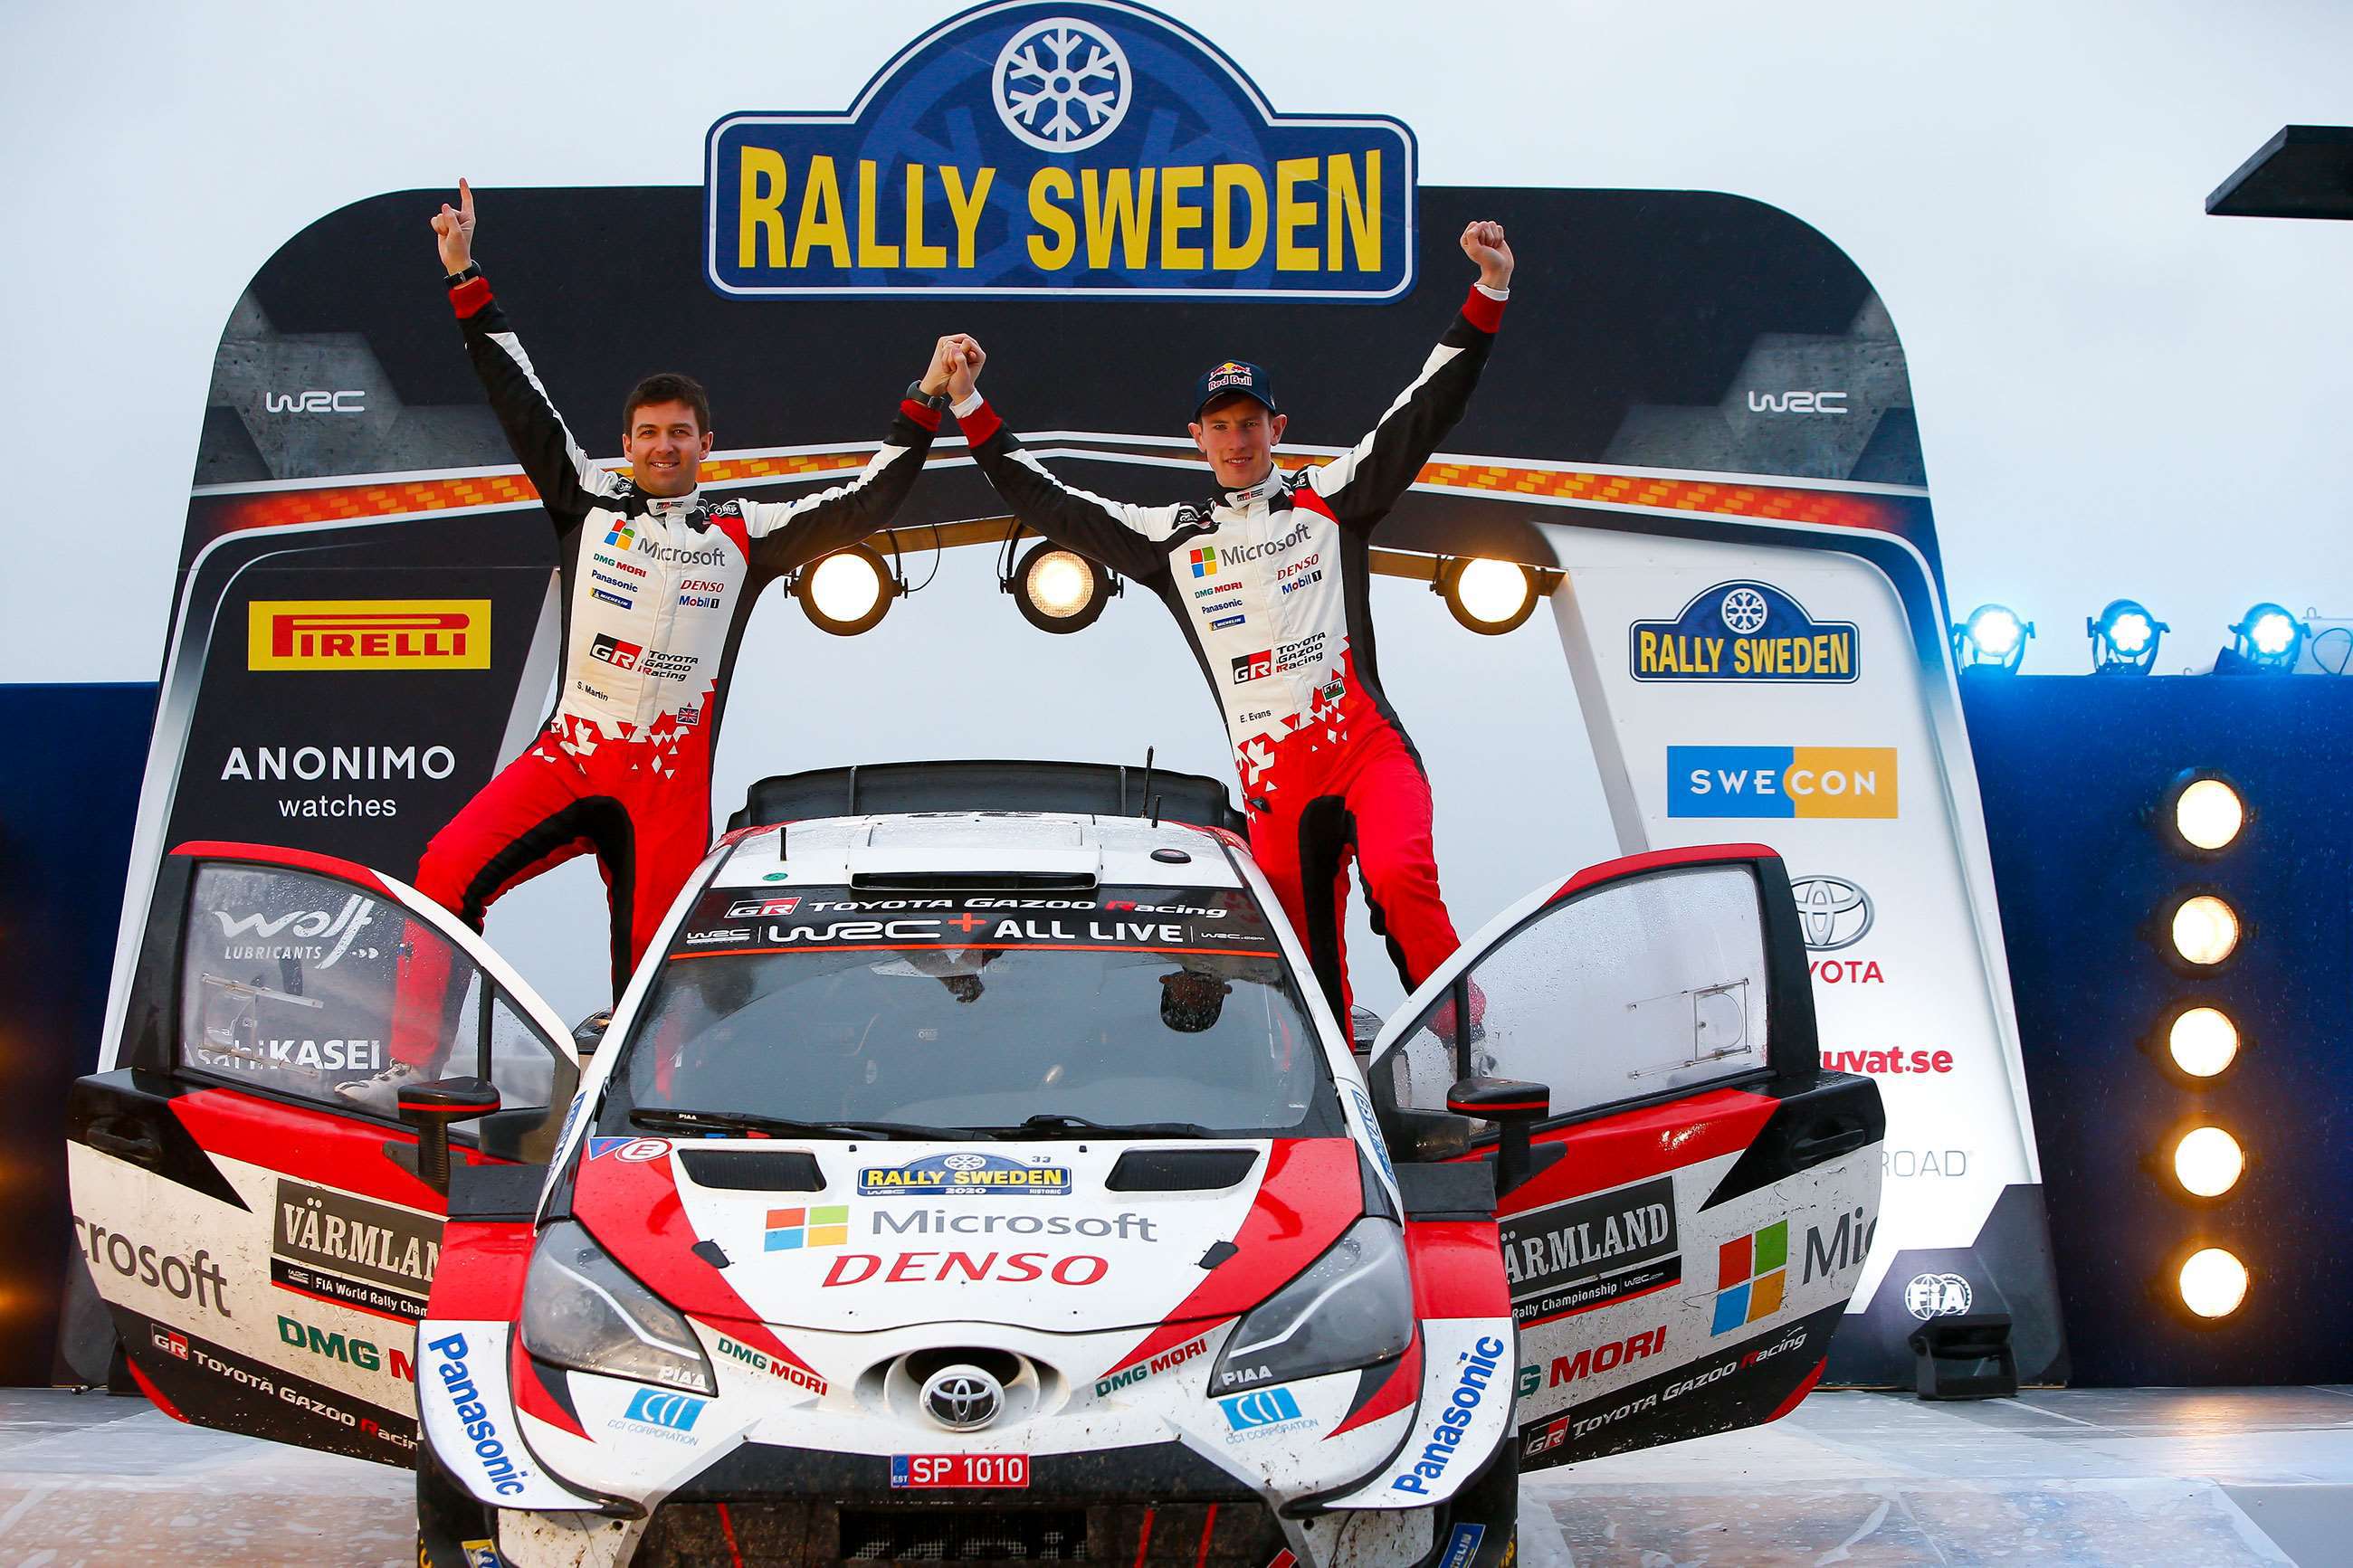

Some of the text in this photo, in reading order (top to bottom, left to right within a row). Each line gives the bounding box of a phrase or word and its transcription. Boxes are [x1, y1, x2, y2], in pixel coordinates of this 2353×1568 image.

[738, 146, 1382, 271] RALLY SWEDEN
[1208, 375, 1252, 391] Red Bull
[265, 390, 366, 413] WRC
[1748, 391, 1848, 413] WRC
[638, 537, 726, 566] Microsoft
[1221, 523, 1311, 566] Microsoft
[594, 553, 647, 578] DMG MORI
[1277, 554, 1319, 580] DENSO
[591, 569, 638, 593] Panasonic
[681, 579, 725, 593] DENSO
[1195, 582, 1243, 599] DMG MORI
[1281, 575, 1311, 594] Mobil
[679, 595, 710, 608] Mobil
[1202, 598, 1243, 614] Panasonic
[272, 613, 471, 658] PIRELLI
[1277, 632, 1326, 654] TOYOTA
[591, 643, 636, 670] GR
[649, 650, 700, 664] TOYOTA
[1276, 651, 1323, 673] Racing
[1277, 641, 1323, 664] GAZOO
[1640, 631, 1850, 674] RALLY SWEDEN
[637, 665, 687, 681] Racing
[643, 659, 692, 672] GAZOO
[1234, 660, 1272, 683] GR
[576, 680, 609, 701] S. Martin
[1240, 709, 1272, 723] E. Evans
[221, 746, 456, 781] ANONIMO
[1690, 768, 1876, 795] SWECON
[279, 794, 397, 817] watches
[729, 898, 1228, 918] GR TOYOTA GAZOO Racing
[994, 919, 1076, 939] ALL
[1090, 921, 1184, 943] LIVE
[224, 946, 323, 961] LUBRICANTS
[1819, 1046, 1954, 1074] uvat.se
[1032, 1155, 1052, 1164] 33
[866, 1169, 1062, 1186] RALLY SWEDEN
[944, 1187, 987, 1195] 2020
[872, 1207, 1158, 1244] Microsoft
[821, 1250, 1110, 1288] DENSO
[316, 1277, 333, 1292] FIA
[336, 1283, 367, 1301] World
[370, 1292, 397, 1310] Rally
[1512, 1304, 1539, 1318] Rally
[1541, 1283, 1617, 1311] Championship
[277, 1315, 381, 1372] DMG
[718, 1337, 828, 1396] DMG MORI
[1095, 1337, 1208, 1398] DMG MORI
[1549, 1325, 1668, 1389] MORI
[154, 1333, 187, 1357] GR
[193, 1350, 275, 1395] TOYOTA
[279, 1385, 356, 1427] GAZOO
[658, 1365, 707, 1388] PIAA
[1223, 1364, 1273, 1386] PIAA
[1526, 1332, 1807, 1456] GR TOYOTA GAZOO Racing
[428, 1332, 528, 1496] Panasonic
[1392, 1335, 1504, 1496] Panasonic
[607, 1419, 699, 1447] CCI CORPORATION
[1225, 1419, 1319, 1445] CCI CORPORATION
[892, 1458, 1023, 1484] EST SP 1010
